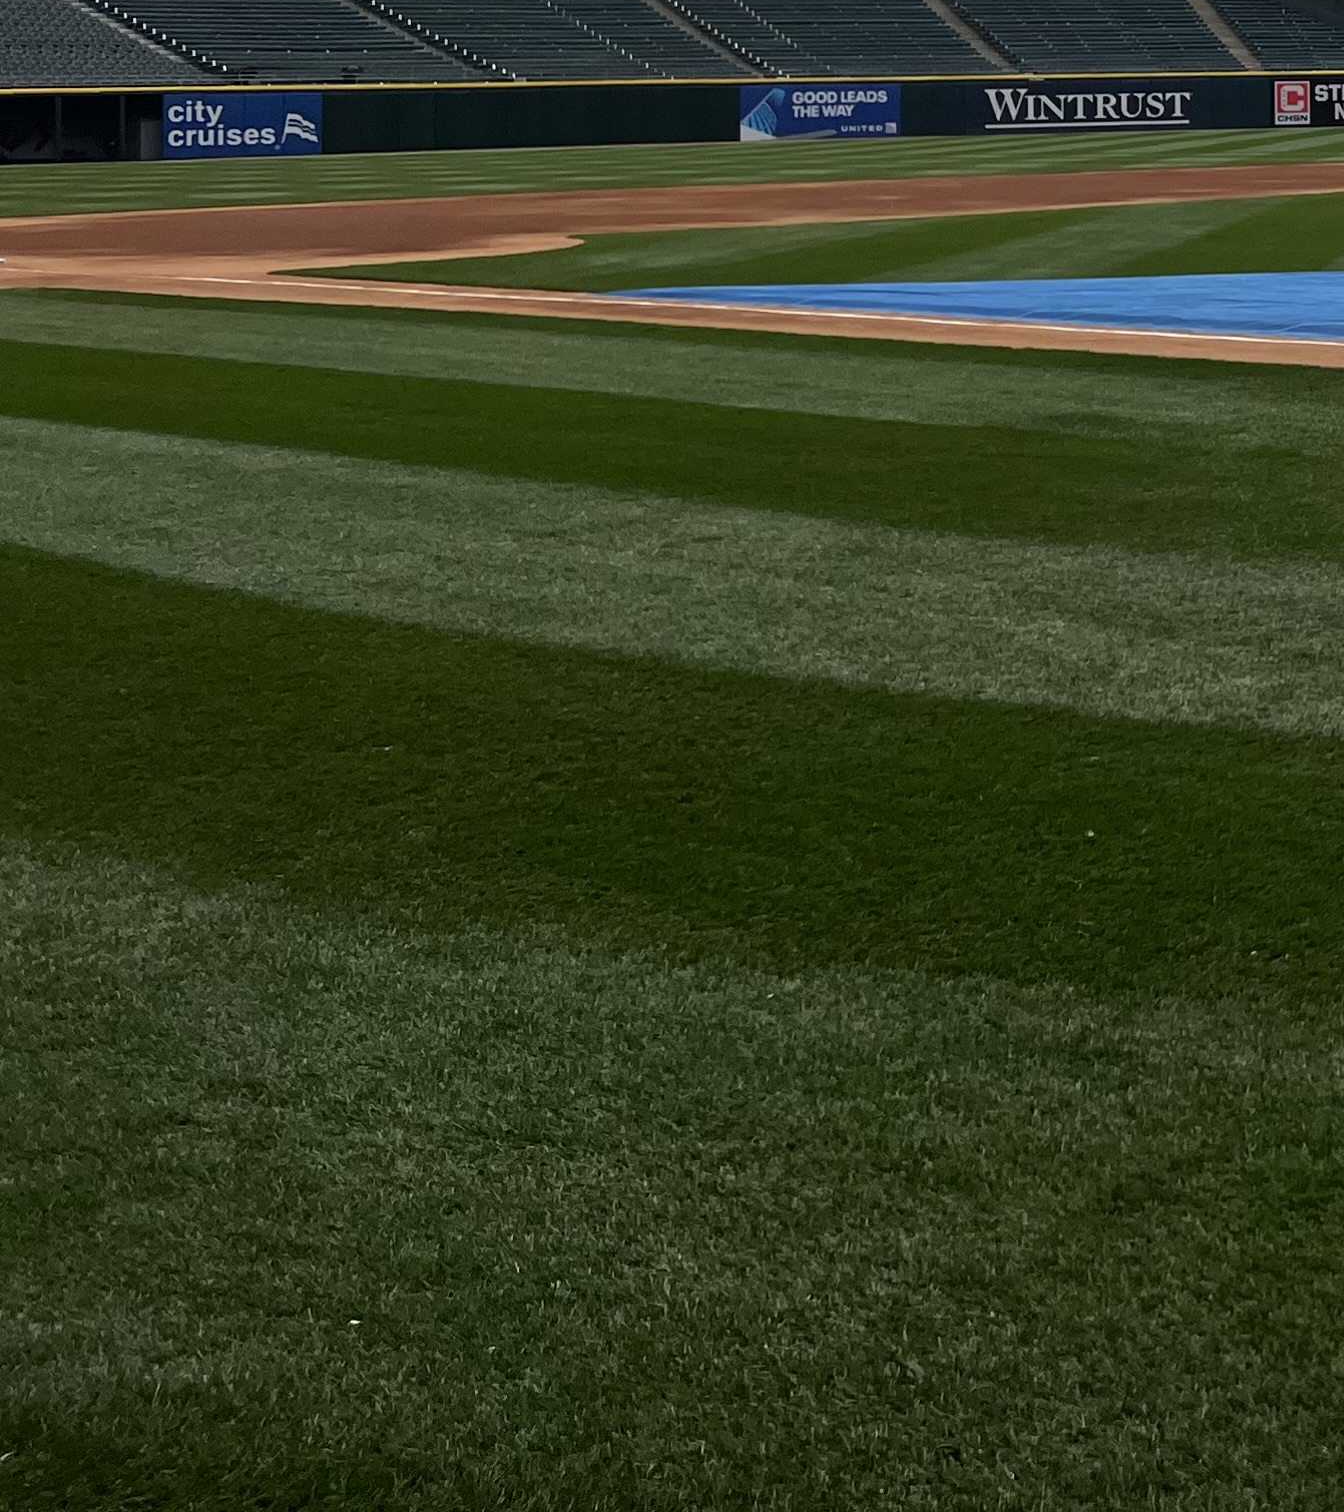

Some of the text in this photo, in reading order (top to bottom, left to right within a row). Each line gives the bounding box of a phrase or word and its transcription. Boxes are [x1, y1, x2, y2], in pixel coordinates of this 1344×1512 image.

[792, 90, 888, 104] GOOD LEADS
[984, 88, 1192, 121] WINTRUST
[168, 100, 223, 127] city
[792, 105, 855, 117] THE WAY
[168, 124, 276, 147] cruises
